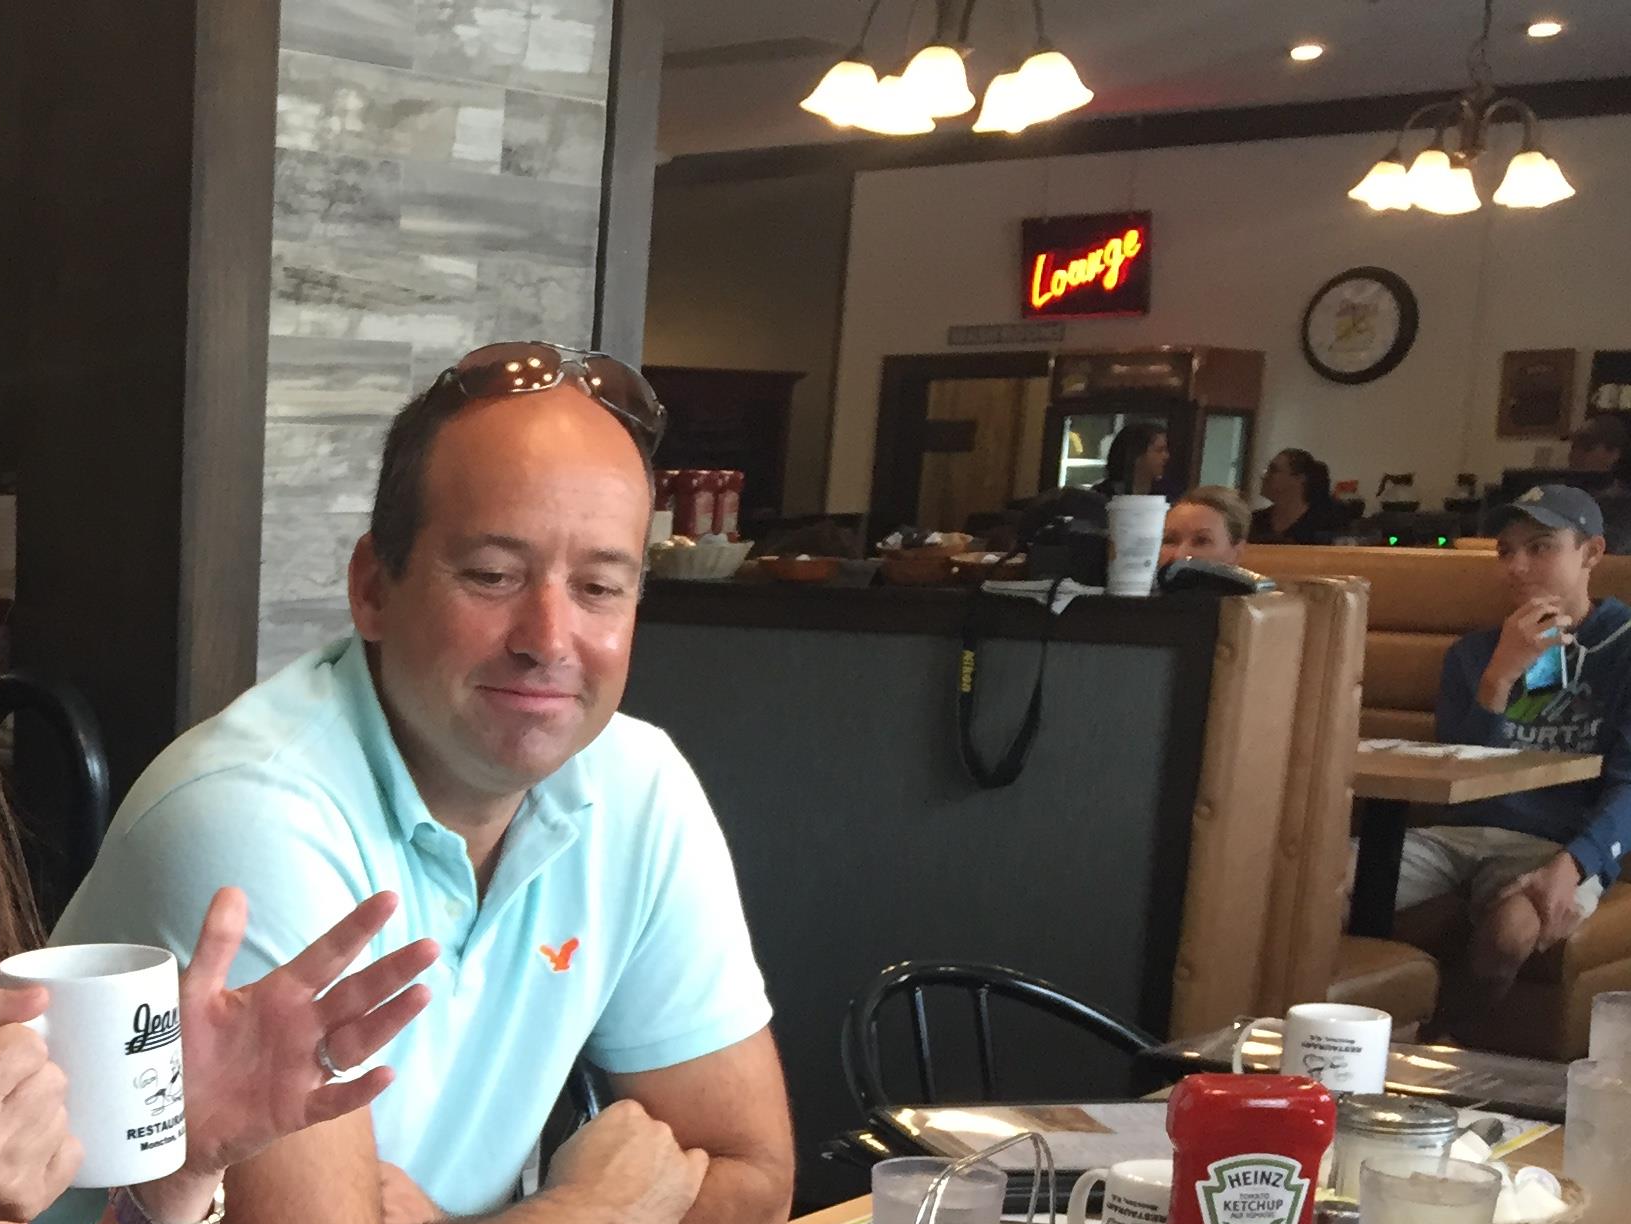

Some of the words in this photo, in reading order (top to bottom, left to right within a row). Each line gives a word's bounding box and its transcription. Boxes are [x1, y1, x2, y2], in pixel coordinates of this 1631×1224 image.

[1031, 229, 1142, 308] Lounge
[1228, 1171, 1283, 1188] HEINZ
[1224, 1199, 1283, 1211] KETCHUP
